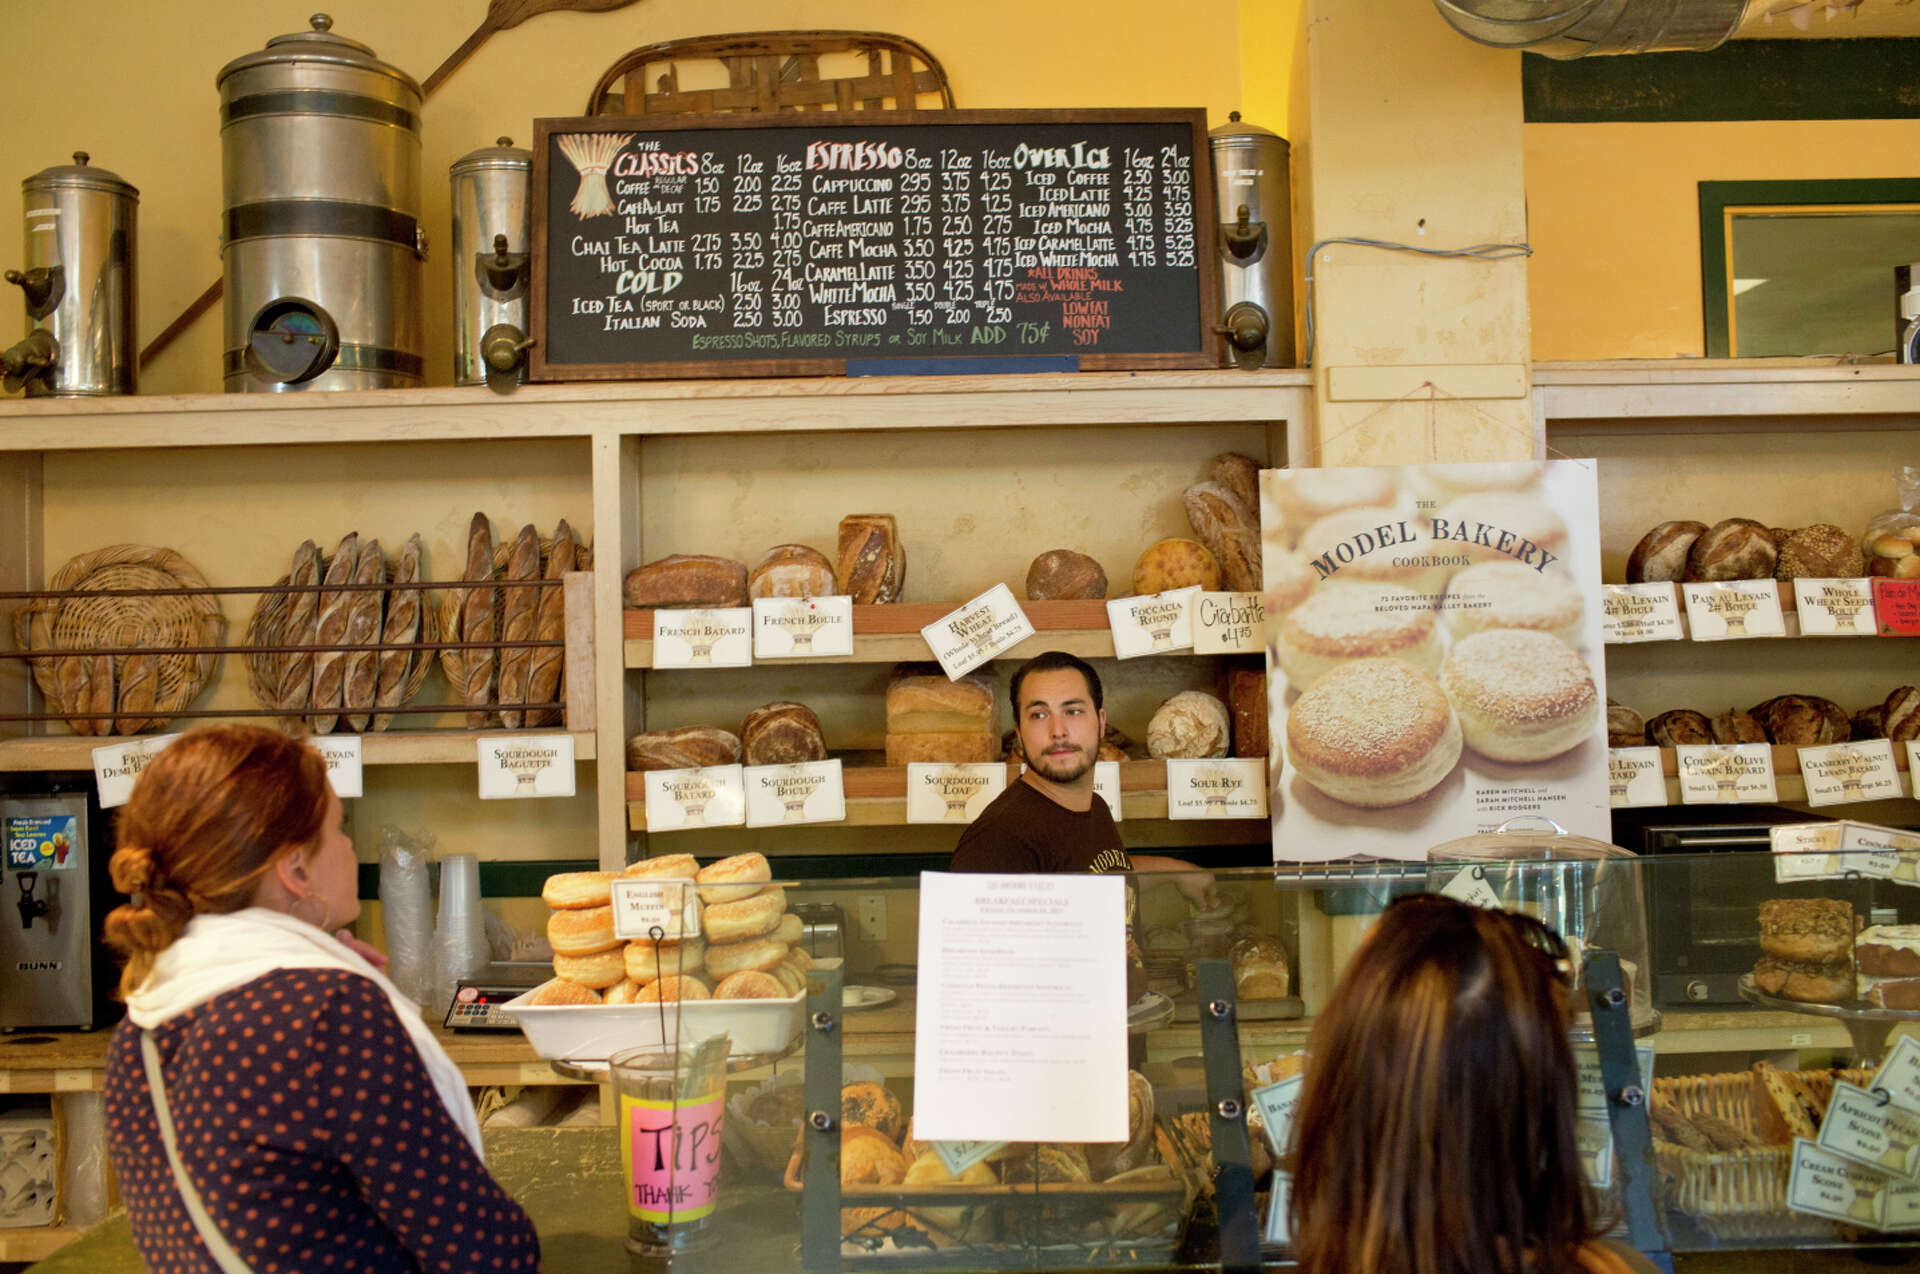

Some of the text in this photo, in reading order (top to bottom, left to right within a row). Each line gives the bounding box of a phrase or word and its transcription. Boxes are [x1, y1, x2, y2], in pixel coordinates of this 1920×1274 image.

[638, 141, 661, 151] THE
[805, 141, 902, 171] ESPRESSO
[1014, 141, 1112, 170] OVER ICE
[614, 152, 699, 177] CLASSICS
[813, 175, 893, 193] CAPPUCCINO
[1024, 170, 1110, 186] ICED COFFEE
[616, 180, 650, 195] COFFEE
[1038, 186, 1069, 201] ICED
[1070, 186, 1111, 201] LATTE
[808, 197, 848, 216] CAFFE
[854, 195, 893, 214] LATTE
[1019, 203, 1047, 218] ICED
[1048, 202, 1110, 217] AMERICANO
[626, 216, 651, 234] HOT
[654, 215, 679, 233] TEA
[1033, 220, 1062, 234] ICED
[1066, 219, 1112, 234] MOCHA
[572, 235, 609, 256] CHAI
[615, 236, 642, 255] TEA
[650, 236, 685, 254] LATTE
[810, 238, 898, 259] CAFFE MOCHA
[1013, 236, 1037, 251] ICED
[1038, 235, 1086, 251] CARAMEL
[1087, 236, 1116, 251] LATTE
[601, 256, 628, 273] HOT
[639, 254, 683, 271] COCOA
[1014, 251, 1038, 268] ICED
[1039, 251, 1079, 267] WHITE
[1080, 251, 1119, 267] MOCHA
[616, 270, 683, 295] COLD
[1050, 279, 1123, 291] WHOLE MILK
[572, 298, 604, 314] ICED
[606, 296, 633, 312] TEA
[679, 303, 691, 311] OR
[693, 294, 725, 313] BLACK)
[1016, 292, 1040, 303] ALSO
[1063, 301, 1109, 315] LOWFAT
[603, 315, 660, 331] ITALIAN
[671, 312, 706, 328] SODA
[824, 305, 887, 326] ESPRESSO
[1063, 315, 1111, 328] NONFAT
[692, 321, 1051, 349] ESPRESSO FLAVORED SYRUPS SOY MILK ADD 75¢
[1072, 329, 1099, 345] SOY
[1416, 501, 1437, 509] THE
[1310, 518, 1559, 581] MODEL BAKERY
[1392, 555, 1471, 568] COOKBOOK
[1391, 594, 1427, 602] FAVORITE
[1692, 592, 1771, 604] PAIN AU LEVAIN
[1822, 586, 1859, 597] WHOLE
[1616, 595, 1669, 606] AU LEVAIN
[1726, 602, 1758, 612] BOULE
[1804, 596, 1840, 606] WHEAT
[1130, 602, 1183, 618] FOCCACIA
[1375, 604, 1409, 612] BELOVED
[1411, 603, 1431, 611] NAPA
[1623, 605, 1656, 616] BOULE
[764, 614, 844, 626] FRENCH BOULE
[949, 605, 991, 633] HARVEST
[1139, 612, 1178, 626] ROUND
[659, 625, 746, 637] FRENCH BATARD
[956, 614, 994, 638] WHEAT
[326, 751, 354, 760] EVAIN
[494, 749, 558, 760] SOURDOUGH
[1734, 755, 1765, 765] OLIVE
[500, 759, 552, 769] BAGUETTE
[1618, 760, 1655, 770] LEVAIN
[1805, 758, 1850, 769] CRANBERRY
[103, 766, 131, 778] DEMI
[1726, 766, 1766, 775] BATARD
[1818, 765, 1880, 777] LEVAIN BATARD
[761, 775, 825, 788] SOURDOUGH
[925, 774, 989, 785] SOURDOUGH
[1190, 777, 1243, 788] SOUR RYE
[674, 790, 716, 801] BATARD
[777, 786, 811, 797] BOULE
[943, 784, 969, 795] LOAF
[10, 839, 37, 851] ICED
[11, 851, 36, 864] TEA
[1801, 1159, 1834, 1174] CREAM
